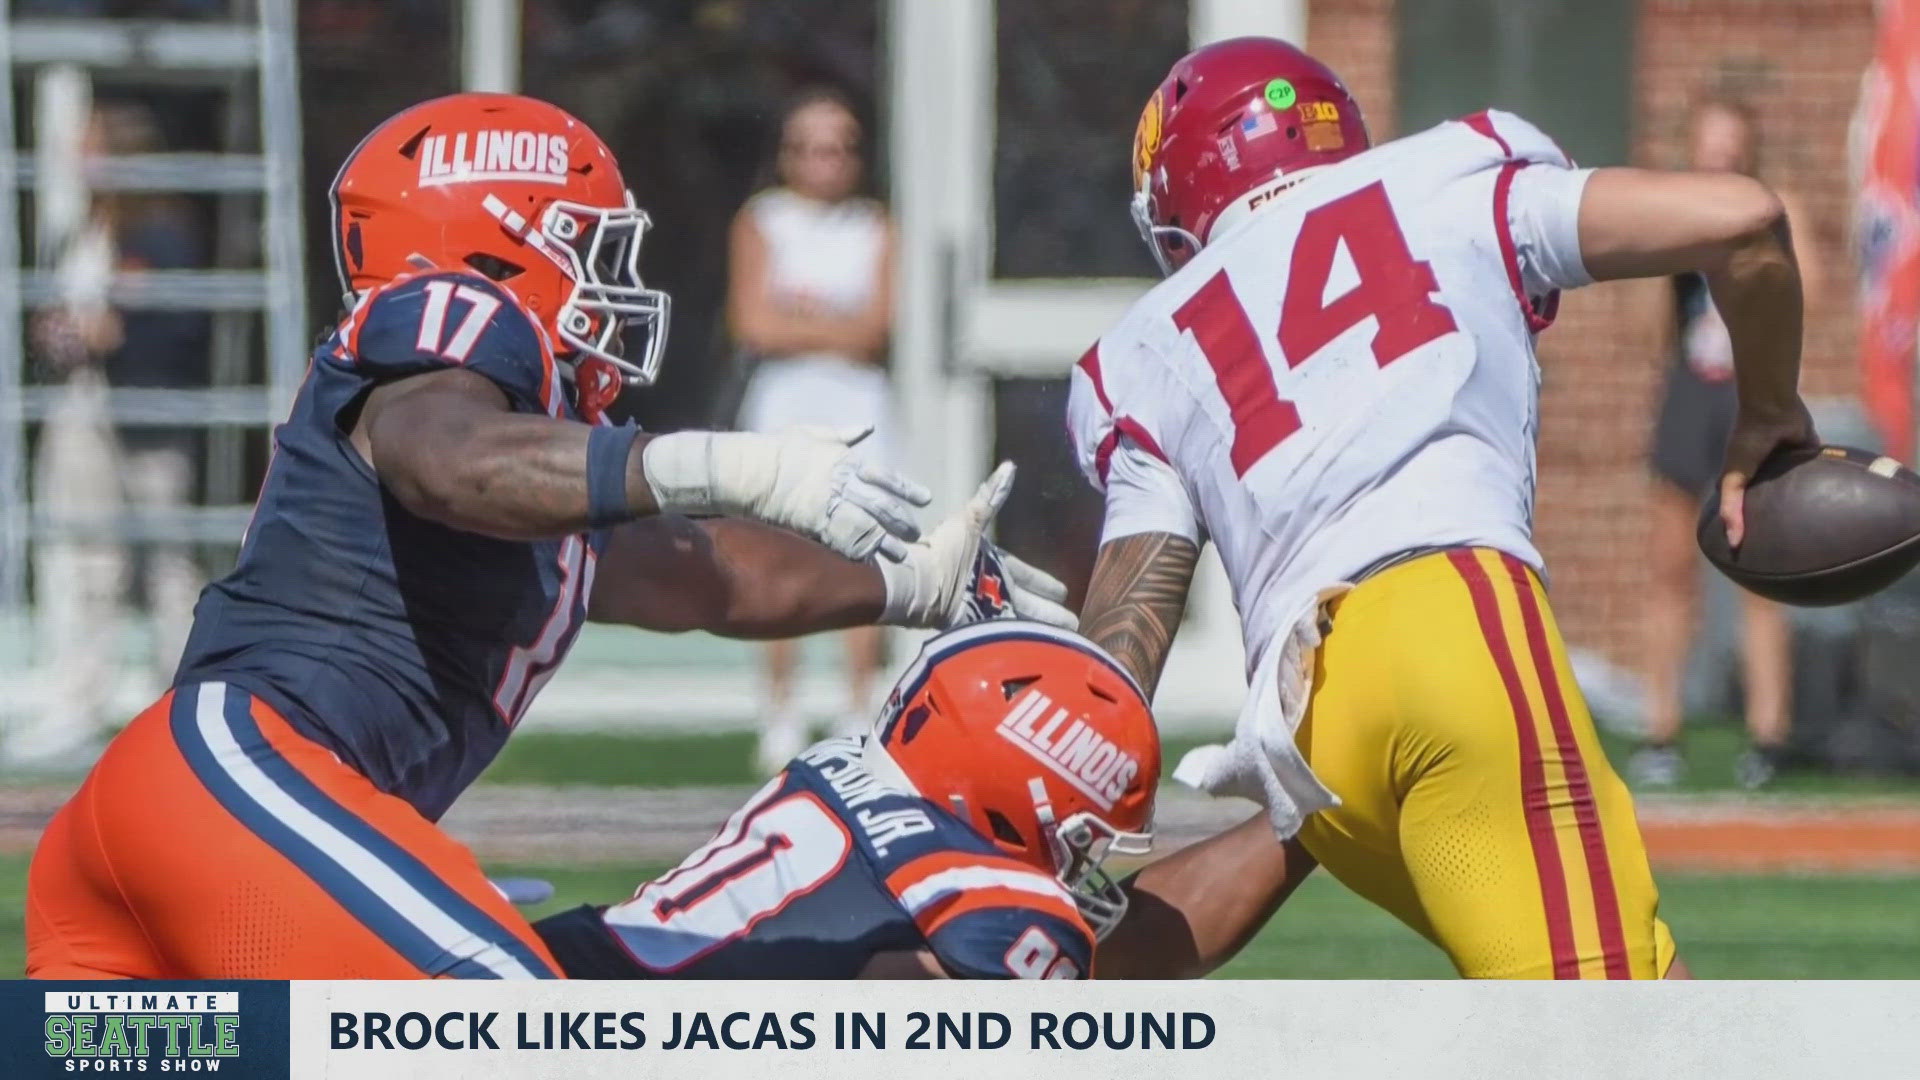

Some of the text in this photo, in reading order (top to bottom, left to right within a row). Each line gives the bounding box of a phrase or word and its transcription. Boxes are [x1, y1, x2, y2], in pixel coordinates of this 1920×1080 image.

[1268, 83, 1292, 100] C2P
[418, 130, 569, 181] ILLINOIS
[416, 279, 502, 365] 17
[1171, 179, 1460, 482] 14
[1000, 688, 1140, 808] ILLINOIS
[856, 807, 936, 858] JR.
